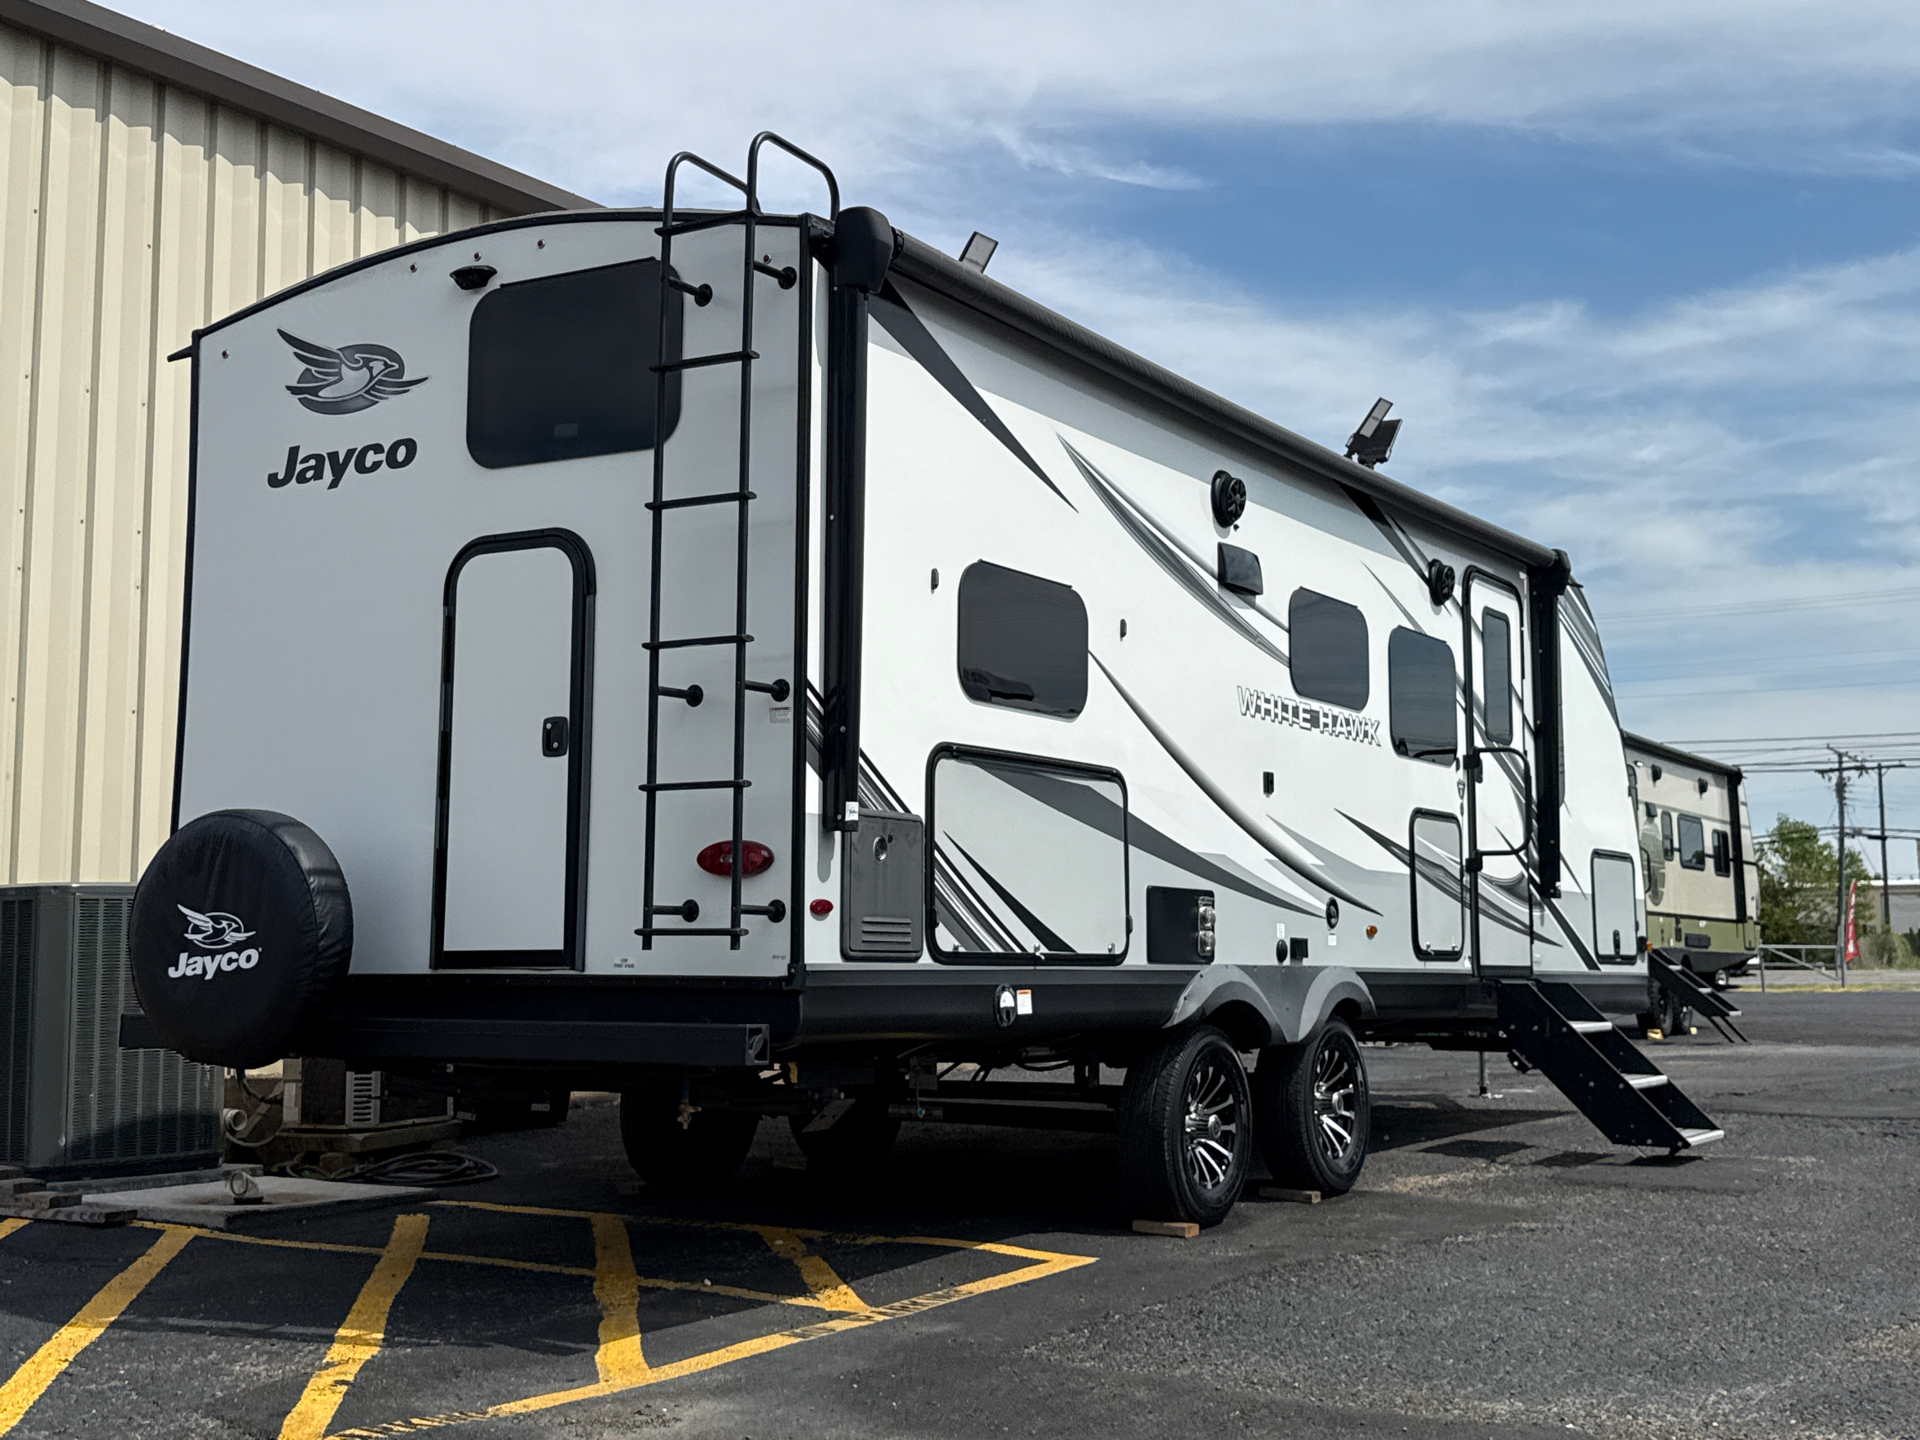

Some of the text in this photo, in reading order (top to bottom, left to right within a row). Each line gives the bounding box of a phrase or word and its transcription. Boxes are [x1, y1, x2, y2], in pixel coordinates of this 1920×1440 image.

[267, 437, 418, 490] Jayco
[1237, 685, 1382, 747] WHITE HAWK
[168, 948, 259, 980] Jayco
